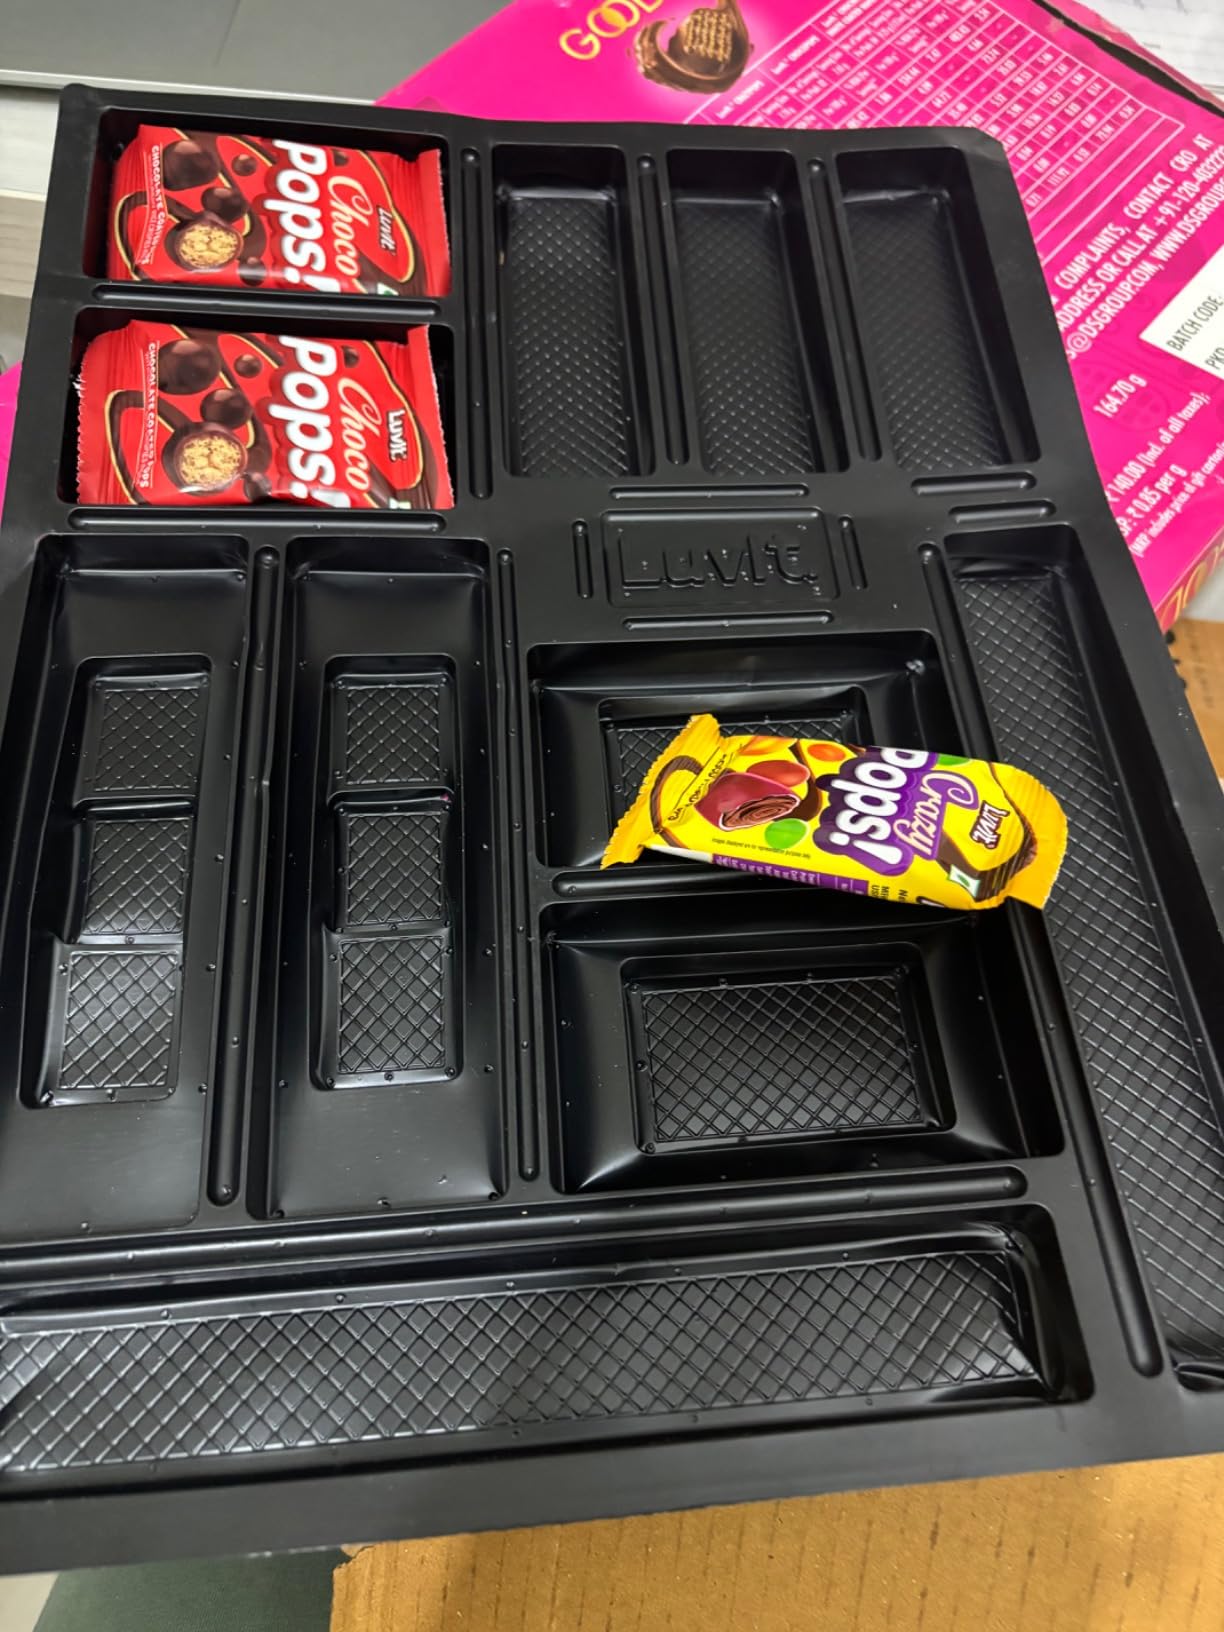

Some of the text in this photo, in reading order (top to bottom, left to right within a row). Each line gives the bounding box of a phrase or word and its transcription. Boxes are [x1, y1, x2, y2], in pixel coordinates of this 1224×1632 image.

[151, 145, 164, 209] CHOCOLATE
[1054, 133, 1213, 290] COMPLAINTS, CONTACT CRO AT
[328, 176, 374, 276] Choco
[1096, 262, 1122, 282] OR
[1112, 239, 1147, 267] CALL
[1135, 223, 1158, 245] AT
[1149, 177, 1224, 262] WWW.DSGROUP
[1166, 319, 1203, 351] BATCH
[148, 343, 157, 408] CHOCOLATE
[1093, 373, 1148, 418] 164.70 g
[337, 377, 382, 490] Choco
[1107, 460, 1147, 495] 140.00
[1158, 428, 1175, 444] of
[1167, 416, 1185, 433] all
[1131, 486, 1162, 512] 0.85
[1154, 472, 1176, 495] per
[1169, 463, 1188, 478] g
[893, 772, 974, 855] Crazy
